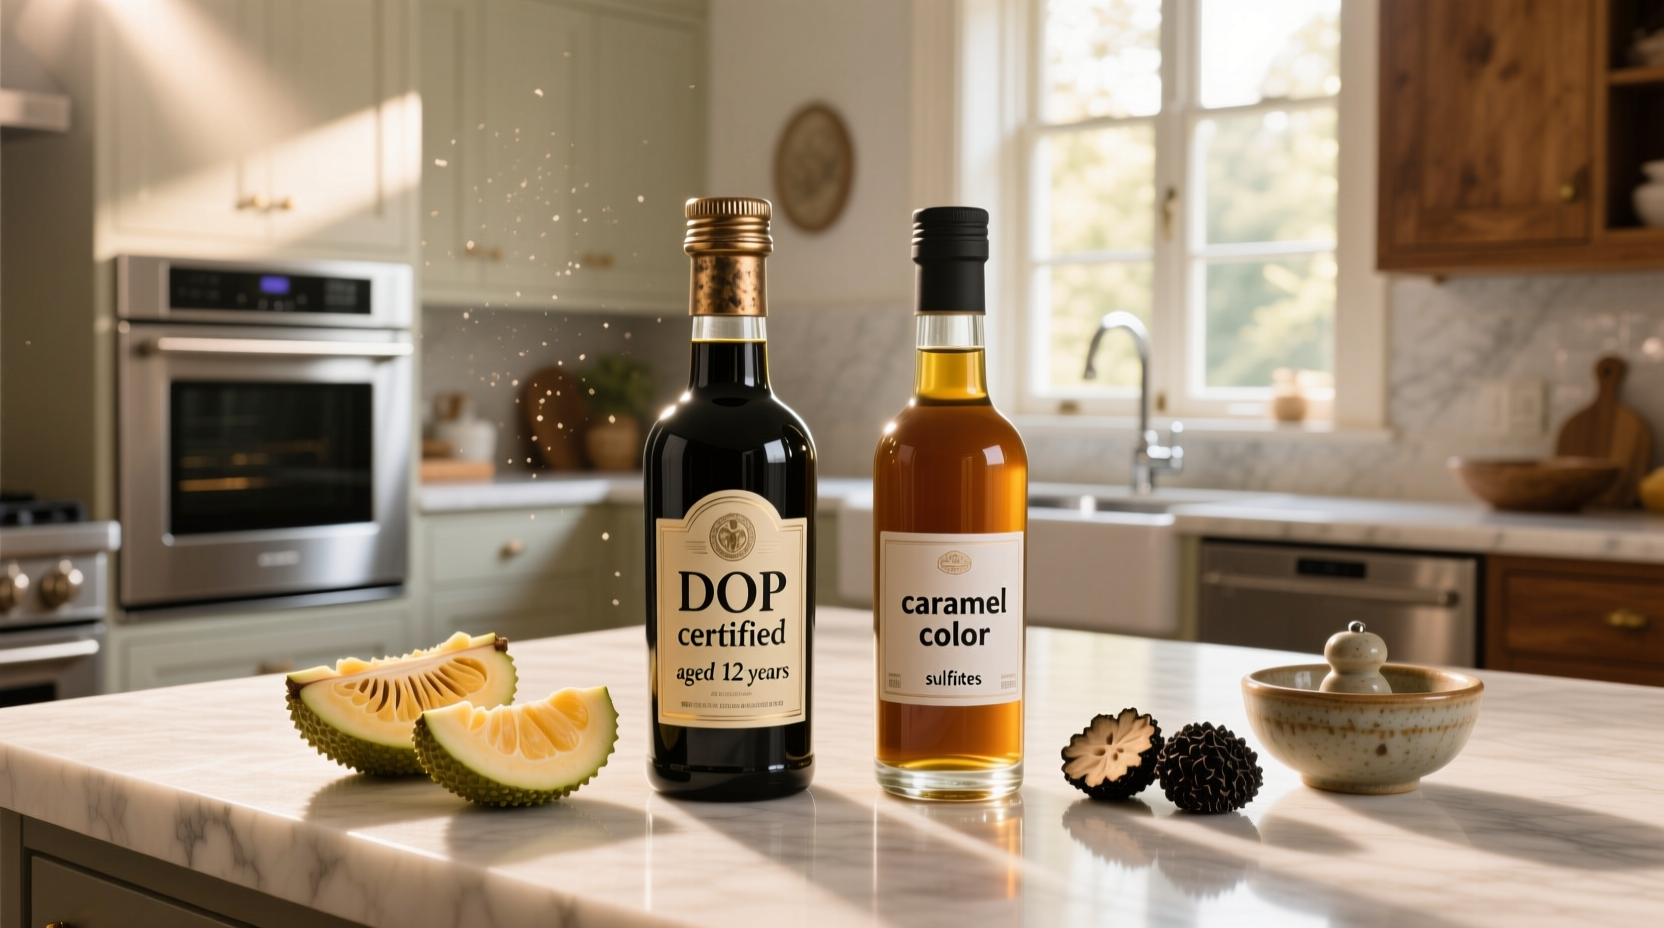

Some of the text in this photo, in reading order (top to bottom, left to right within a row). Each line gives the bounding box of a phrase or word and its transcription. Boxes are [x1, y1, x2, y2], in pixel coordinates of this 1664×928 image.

[678, 571, 787, 613] DOP
[902, 587, 1007, 615] caramel
[678, 618, 786, 647] certified
[919, 620, 990, 647] color
[676, 661, 790, 687] aged 12 years
